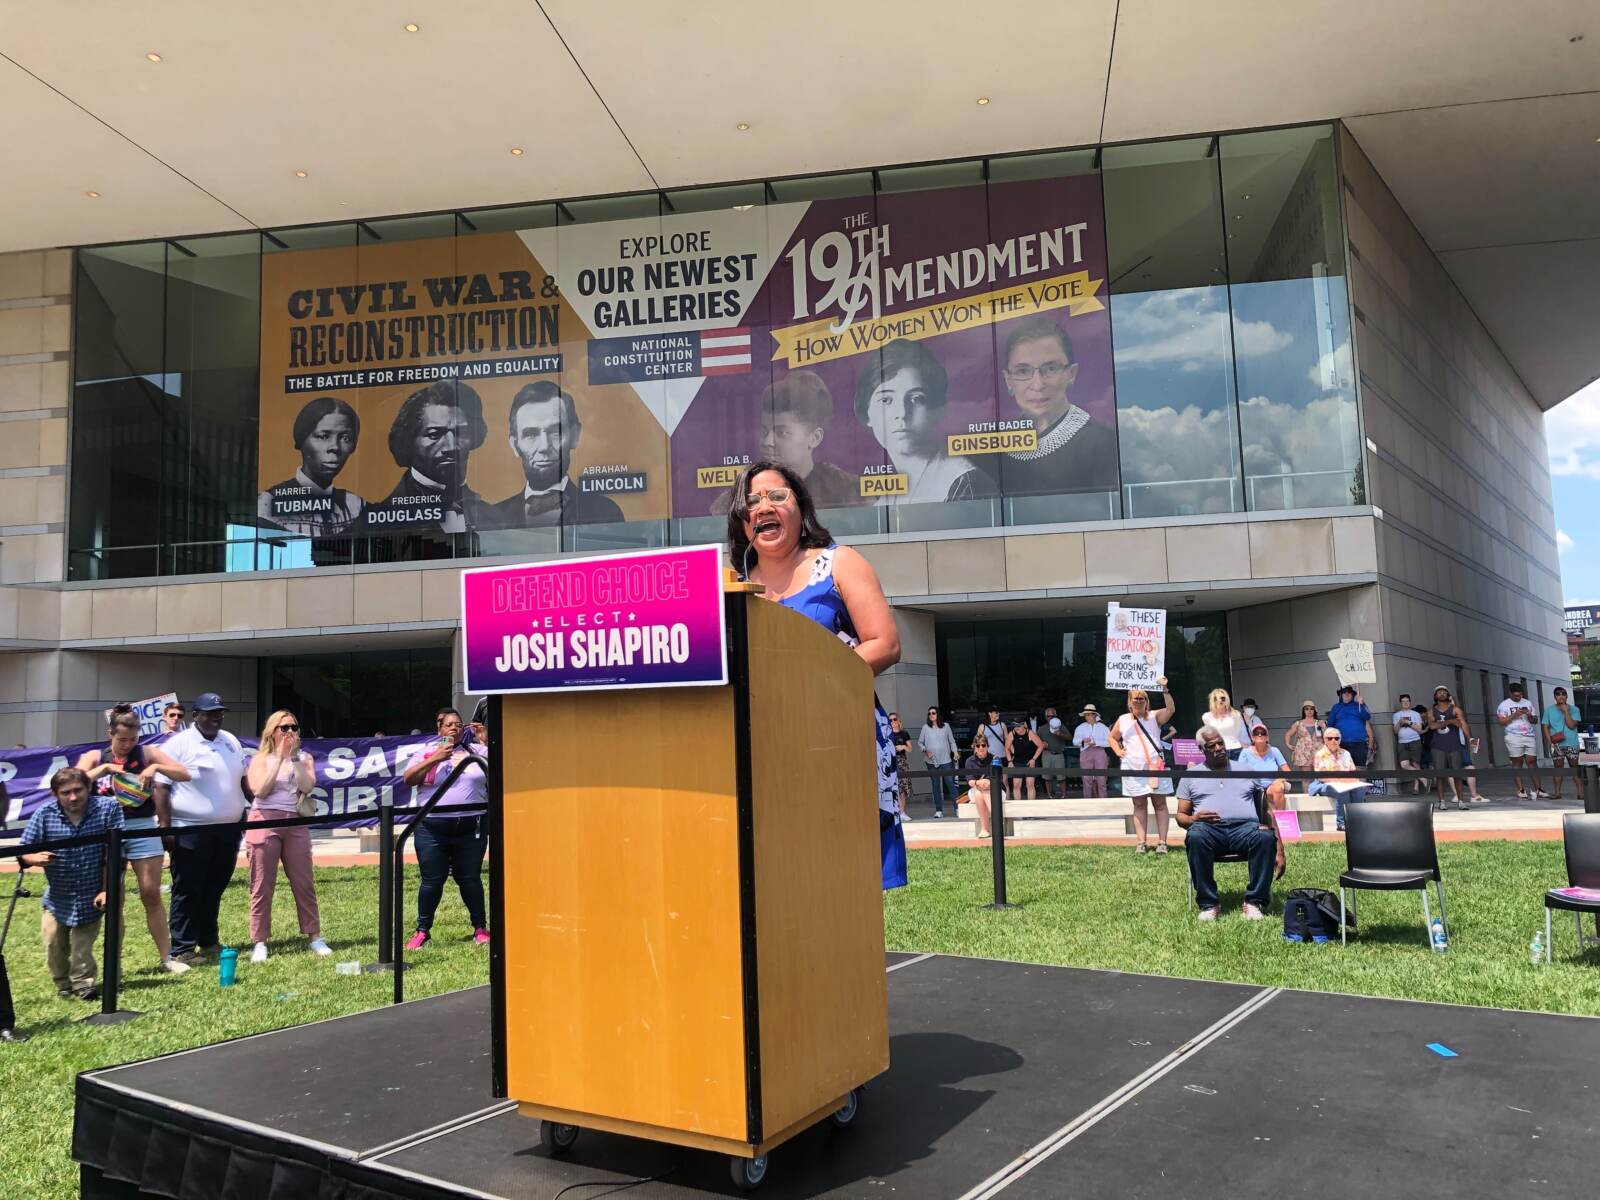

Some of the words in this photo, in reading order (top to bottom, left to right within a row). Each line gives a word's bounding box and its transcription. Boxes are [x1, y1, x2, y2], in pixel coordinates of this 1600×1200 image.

[842, 211, 870, 229] THE
[620, 231, 711, 259] EXPLORE
[577, 266, 634, 296] OUR
[644, 253, 757, 290] NEWEST
[830, 222, 1087, 334] AMENDMENT
[288, 281, 416, 320] CIVIL
[422, 270, 536, 308] WAR
[540, 275, 559, 298] &
[594, 290, 741, 328] GALLERIES
[794, 334, 843, 362] HOW
[850, 316, 925, 350] WOMEN
[929, 303, 982, 331] WON
[988, 293, 1024, 315] THE
[1028, 280, 1083, 309] VOTE
[289, 304, 560, 368] RECONSTRUCTION
[632, 337, 692, 351] NATIONAL
[604, 350, 693, 366] CONSTITUTION
[288, 377, 312, 390] THE
[317, 373, 364, 387] BATTLE
[369, 370, 393, 383] FOR
[398, 366, 459, 381] FREEDOM
[464, 363, 490, 376] AND
[495, 358, 559, 374] EQUALITY
[645, 362, 693, 375] CENTER
[968, 422, 996, 432] RUTH
[998, 420, 1033, 430] BADER
[951, 434, 1034, 451] GINSBURG
[723, 456, 740, 464] IDA
[743, 455, 752, 463] B.
[582, 464, 628, 474] ABRAHAM
[863, 464, 893, 475] ALICE
[582, 476, 643, 491] LINCOLN
[701, 470, 737, 484] WEL
[275, 486, 312, 496] HARRIET
[864, 479, 905, 492] PAUL
[275, 499, 331, 513] TUBMAN
[392, 495, 441, 505] FREDERICK
[368, 508, 442, 523] DOUGLASS
[492, 571, 586, 613] DEFEND
[592, 560, 688, 607] CHOICE
[544, 611, 621, 628] ELECT
[1130, 611, 1161, 624] THESE
[1126, 625, 1161, 638] SEXUAL
[495, 630, 564, 673] JOSH
[570, 623, 689, 669] SHAPIRO
[1107, 638, 1153, 653] PREDATORS
[1107, 662, 1148, 671] CHOOSING
[1119, 671, 1134, 680] FOR
[324, 741, 441, 780] SAF
